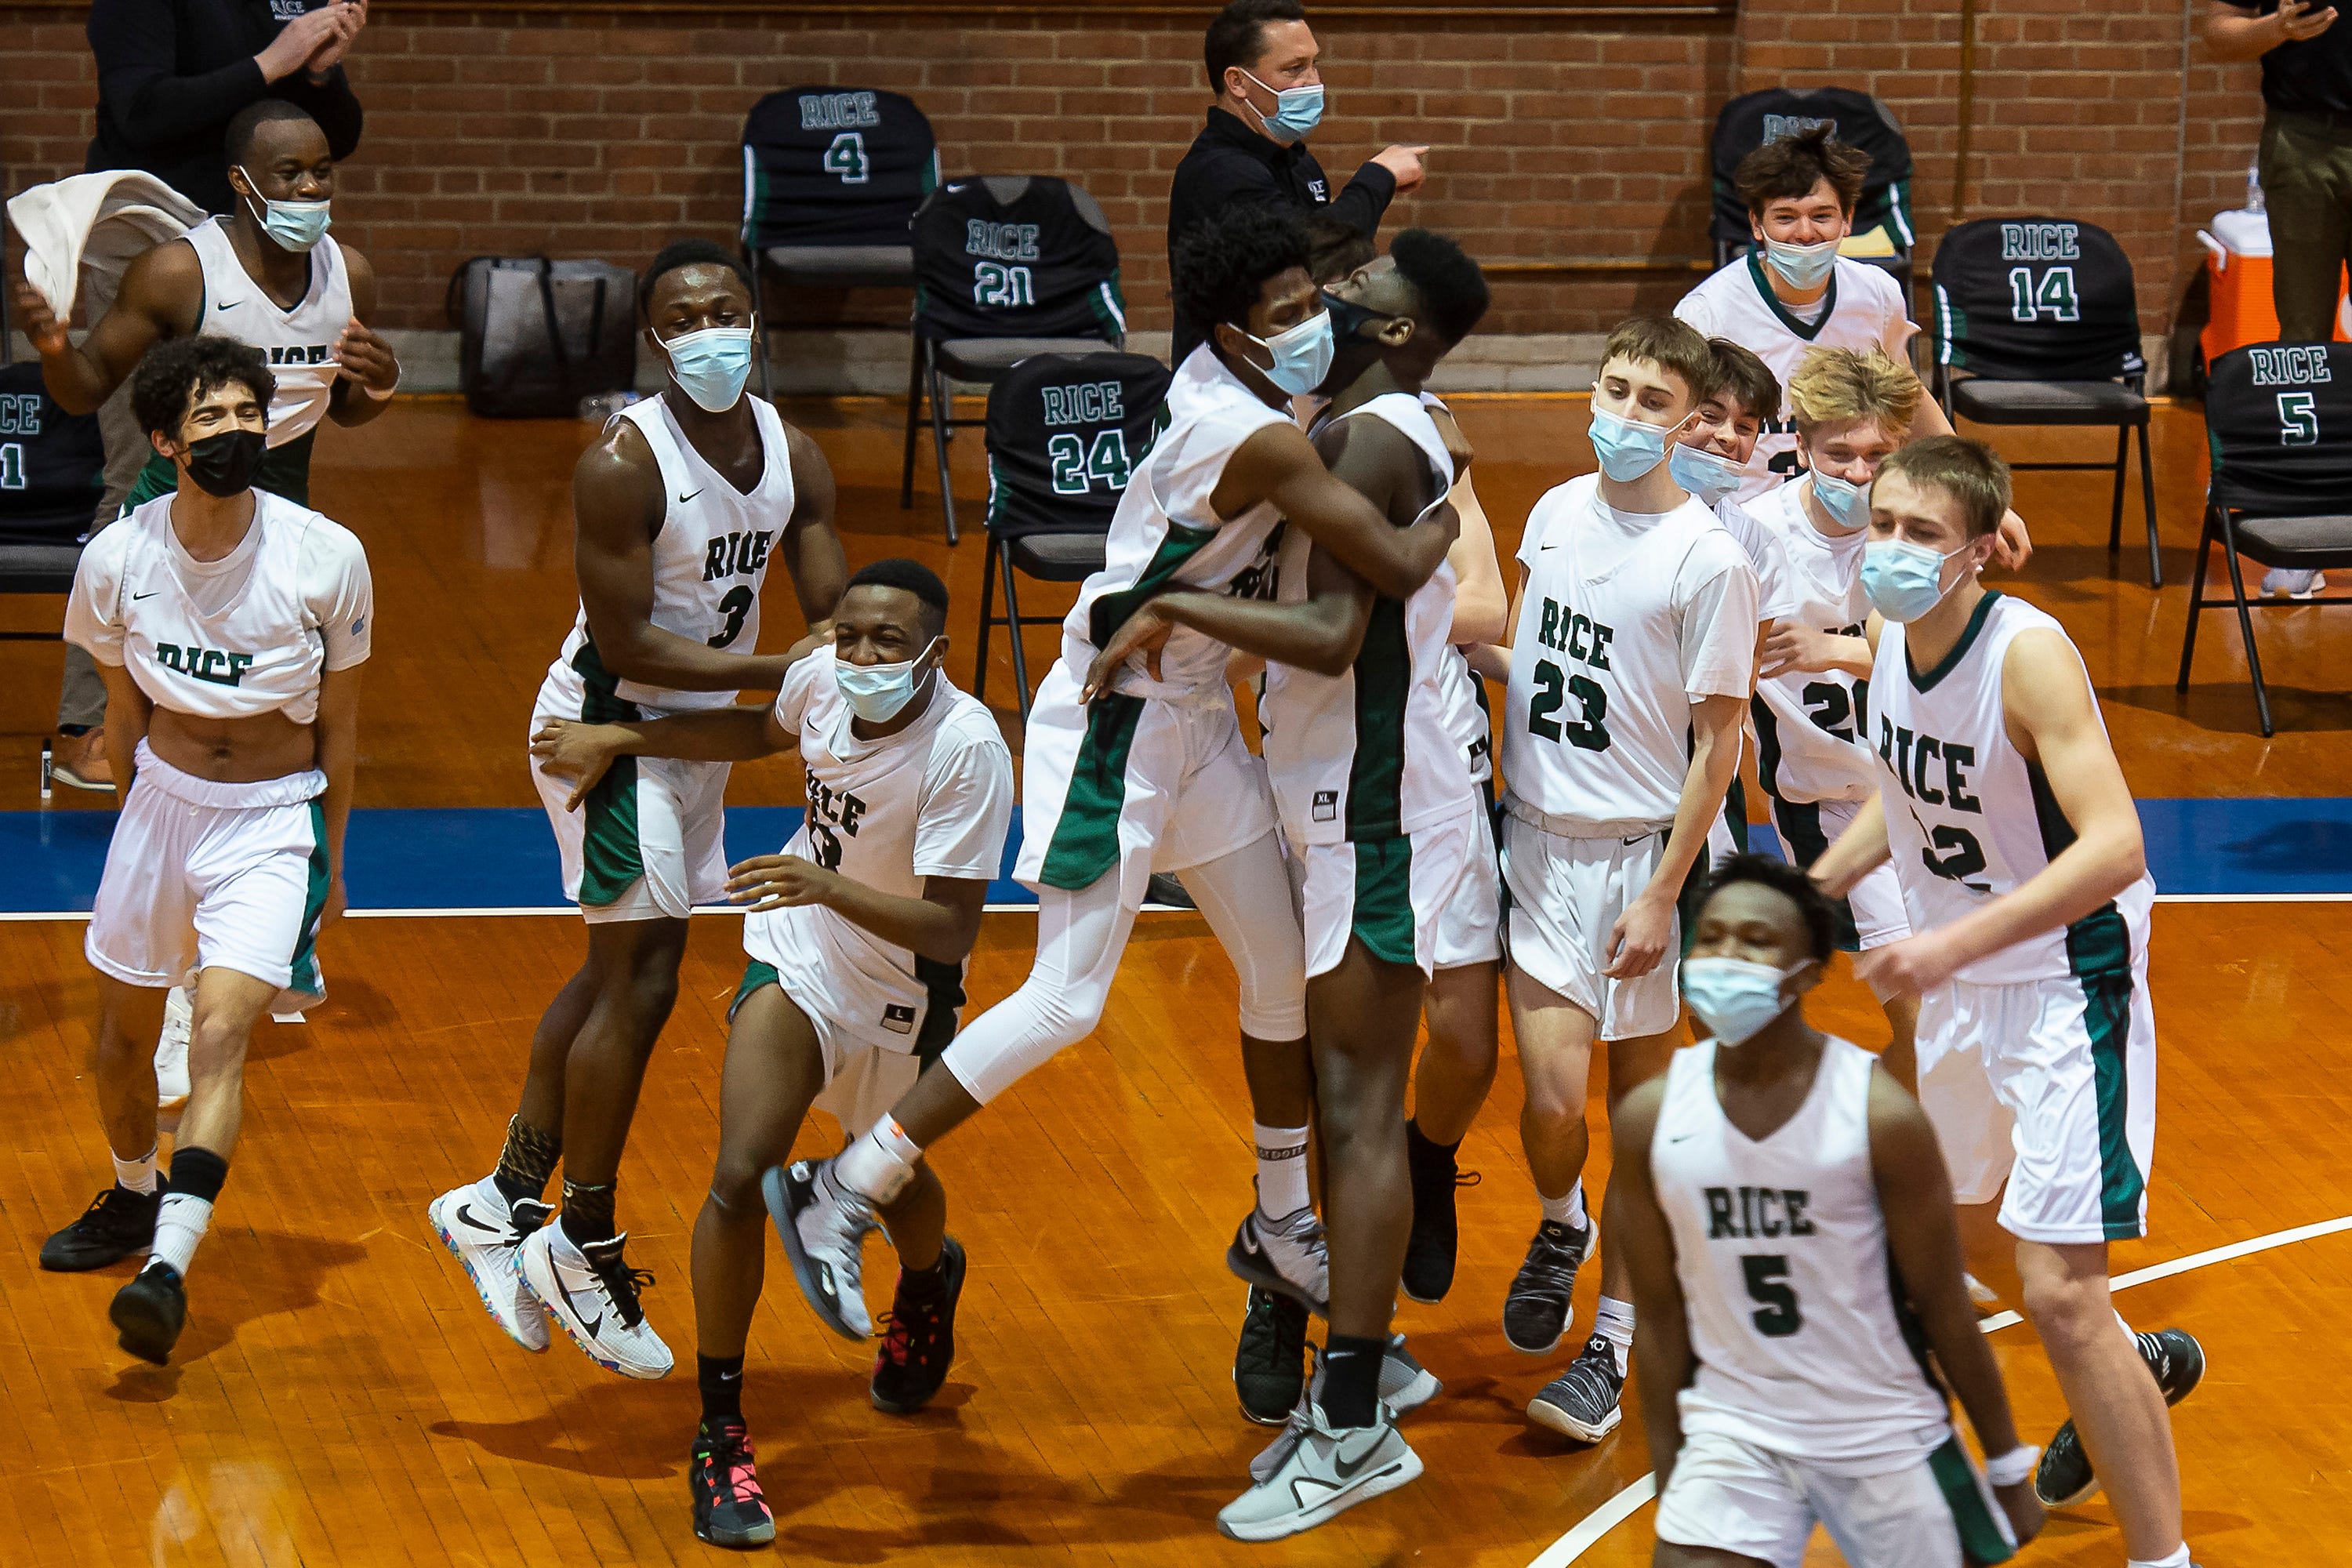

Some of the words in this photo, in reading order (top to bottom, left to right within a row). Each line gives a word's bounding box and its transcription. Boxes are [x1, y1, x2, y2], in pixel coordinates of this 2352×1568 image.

[799, 91, 880, 129] RICE
[824, 132, 869, 183] 4
[966, 219, 1040, 261] RICE
[2000, 223, 2080, 261] RICE
[974, 261, 1035, 306] 21
[2009, 267, 2080, 321] 14
[2248, 346, 2332, 386] RICE
[1041, 381, 1124, 426] RICE
[2277, 392, 2318, 446] 5
[1048, 428, 1131, 495] 24
[702, 530, 775, 582] RICE
[706, 584, 755, 649] 3
[1538, 596, 1614, 672] RICE
[1528, 658, 1612, 753] 23
[1878, 710, 1983, 815] RICE
[1318, 793, 1330, 804] XL
[896, 1008, 904, 1018] L
[1704, 1186, 1817, 1240] RICE
[1740, 1254, 1805, 1338] 5
